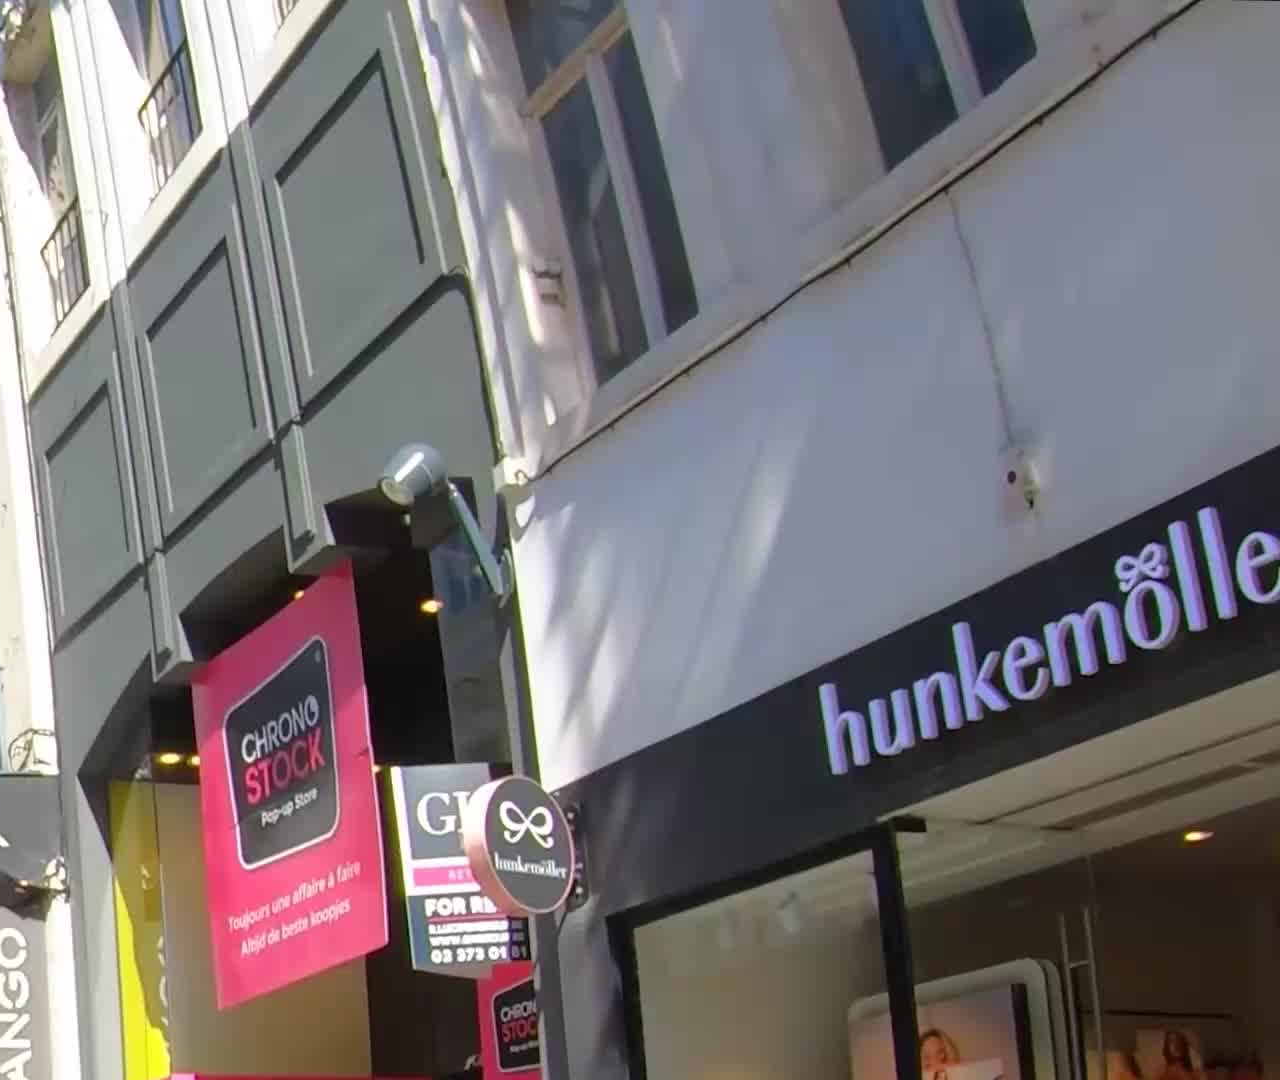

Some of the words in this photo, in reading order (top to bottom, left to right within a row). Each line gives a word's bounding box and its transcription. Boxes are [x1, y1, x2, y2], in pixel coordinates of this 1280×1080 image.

[818, 506, 1280, 776] hunkemölle
[241, 695, 319, 763] CHRONO
[244, 726, 326, 805] STOCK
[424, 896, 467, 917] FOR
[503, 1015, 538, 1041] STOC
